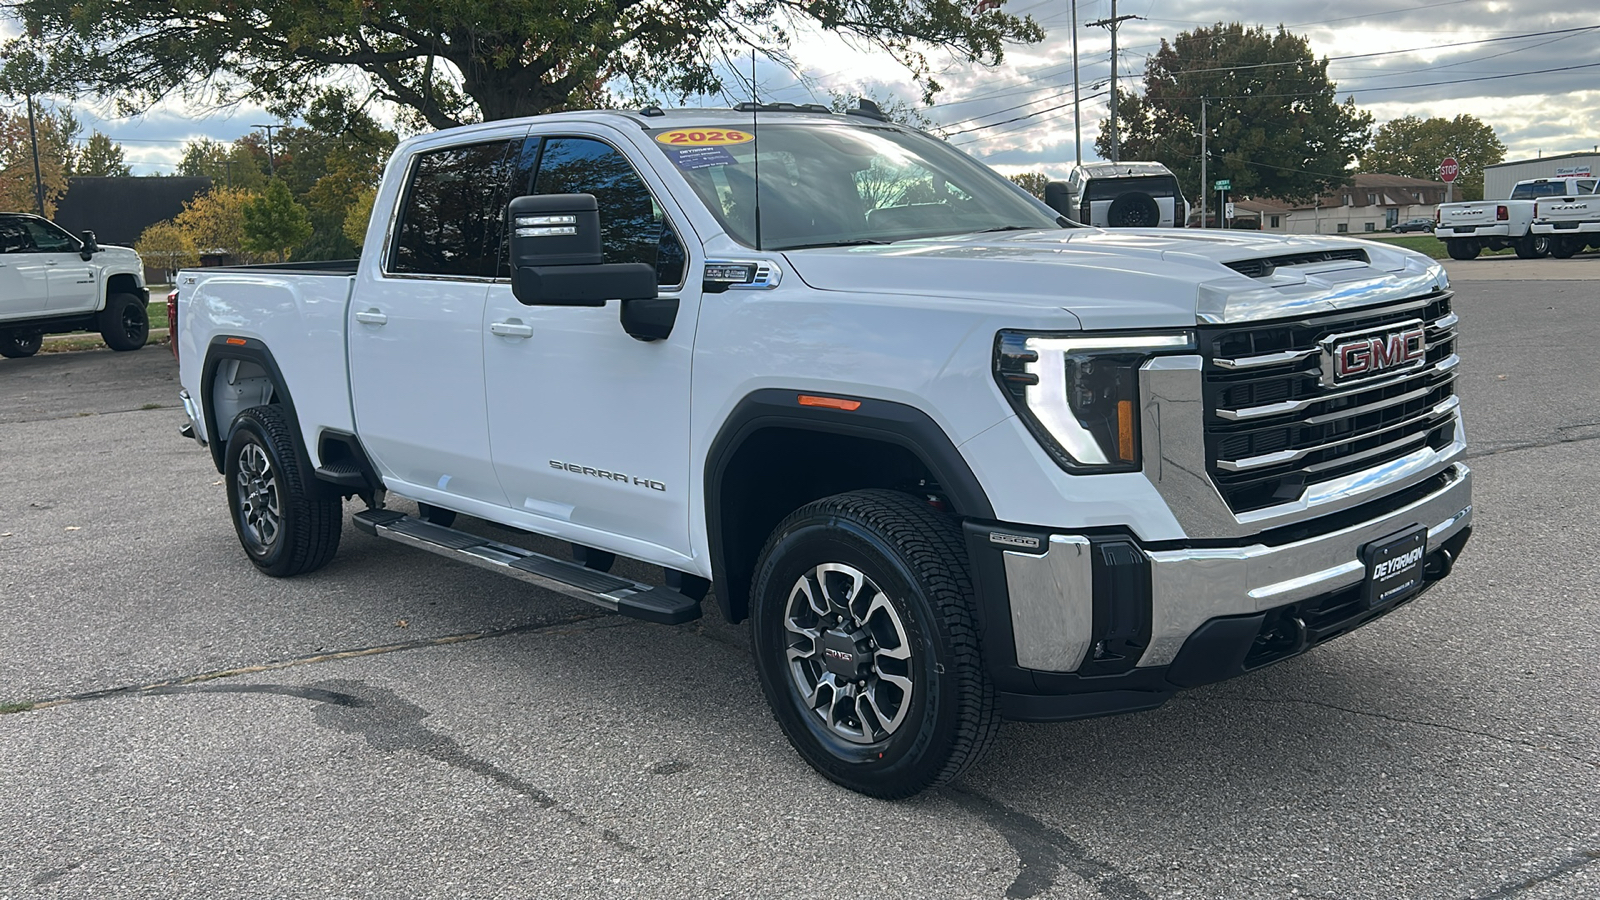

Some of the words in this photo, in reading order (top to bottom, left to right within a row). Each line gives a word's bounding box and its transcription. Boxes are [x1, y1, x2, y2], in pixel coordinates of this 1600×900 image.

[669, 131, 744, 143] 2026
[1441, 165, 1457, 175] STOP
[1335, 329, 1424, 378] GMC
[549, 459, 628, 483] SIERRA
[633, 476, 666, 492] HD
[991, 535, 1037, 545] 2500
[1373, 545, 1424, 580] DEYARMAN
